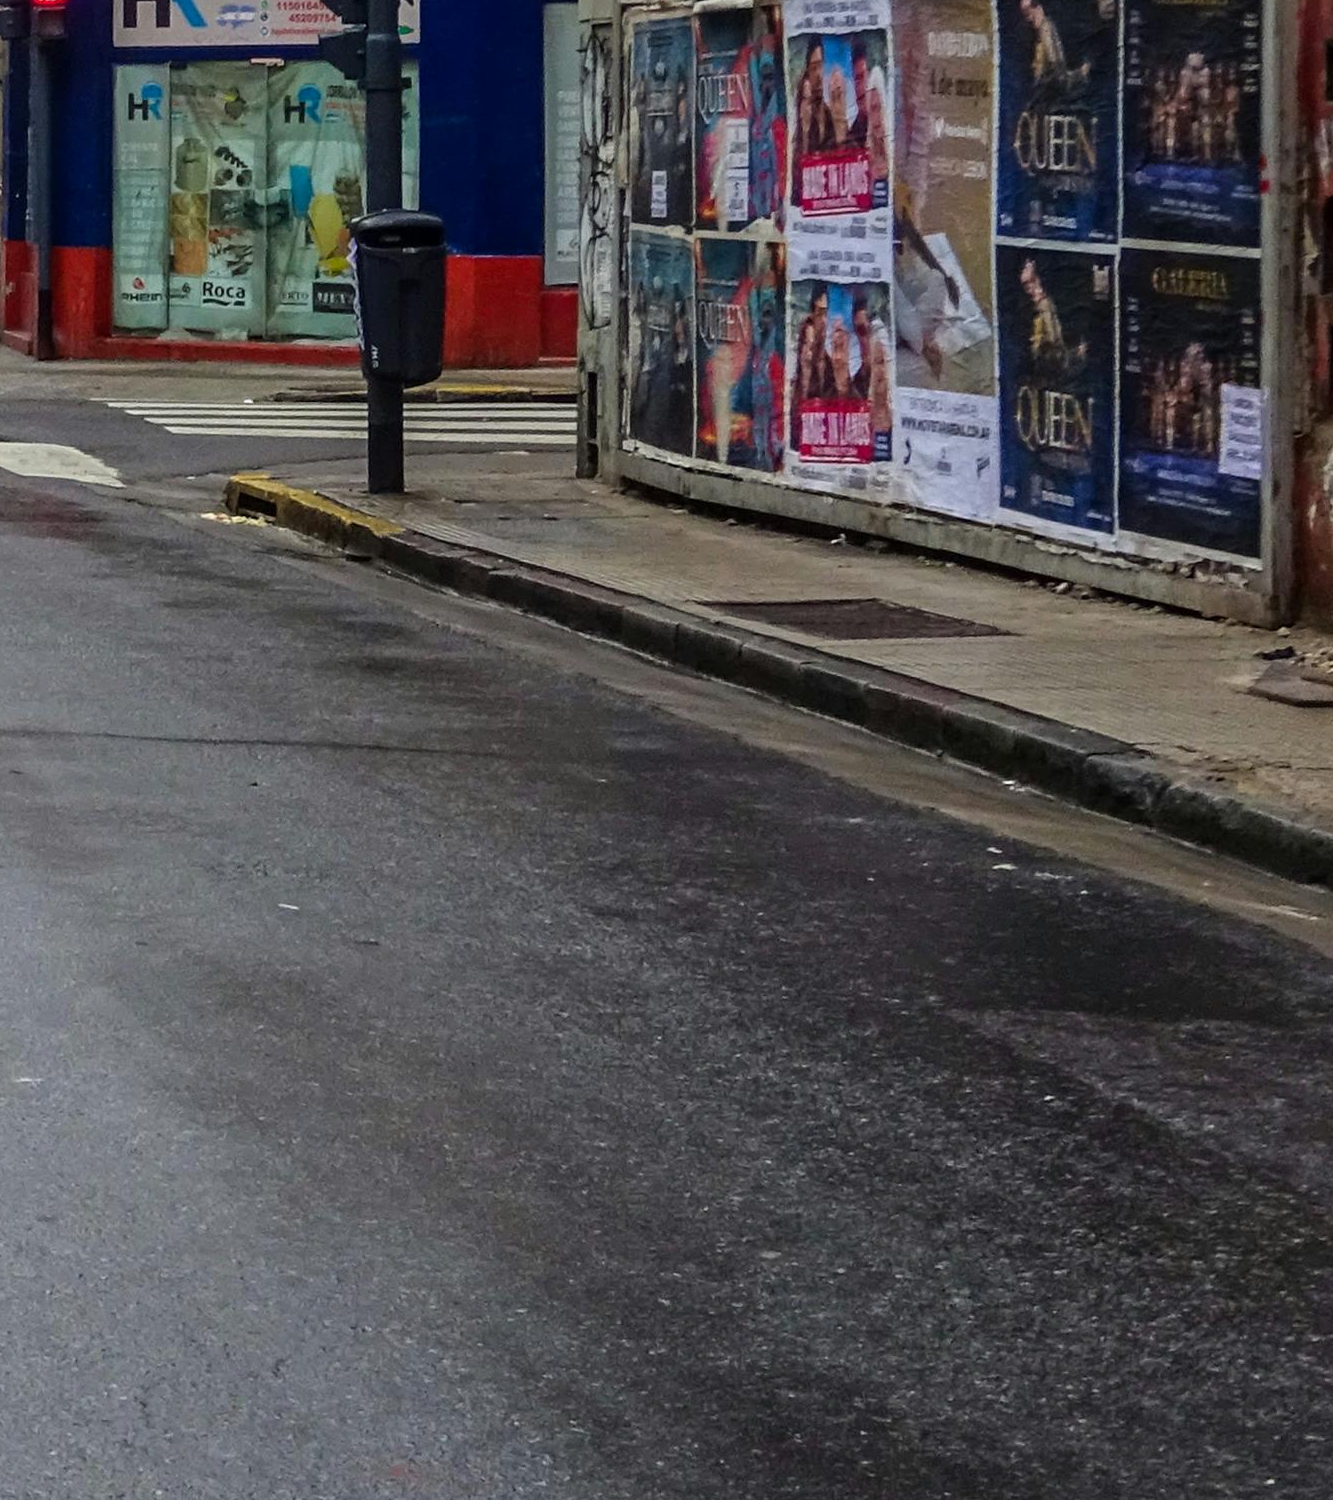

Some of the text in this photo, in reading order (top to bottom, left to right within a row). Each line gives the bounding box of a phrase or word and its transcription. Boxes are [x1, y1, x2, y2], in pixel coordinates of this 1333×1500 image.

[698, 73, 750, 124] QUEEN
[1013, 111, 1098, 176] QUEEN
[202, 281, 246, 299] Roca
[698, 301, 749, 350] QUEEN
[1014, 385, 1094, 451] QUEEN
